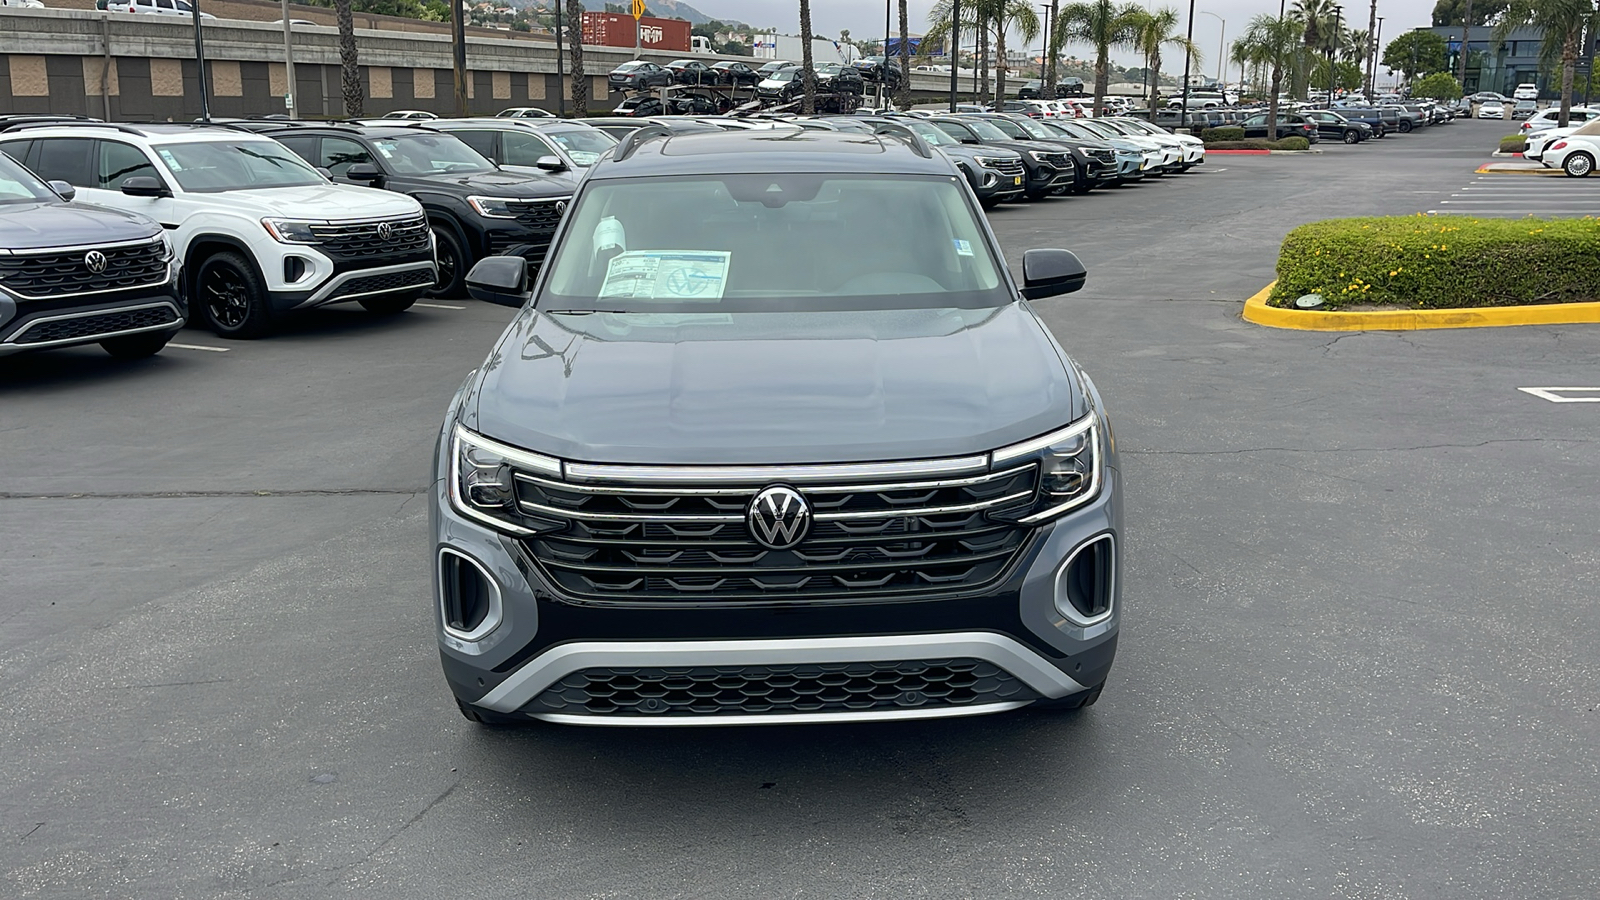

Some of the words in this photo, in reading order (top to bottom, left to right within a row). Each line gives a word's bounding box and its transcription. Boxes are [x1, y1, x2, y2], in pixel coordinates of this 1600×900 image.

[640, 25, 663, 44] HMM
[85, 250, 107, 273] VW
[750, 487, 808, 547] VW
